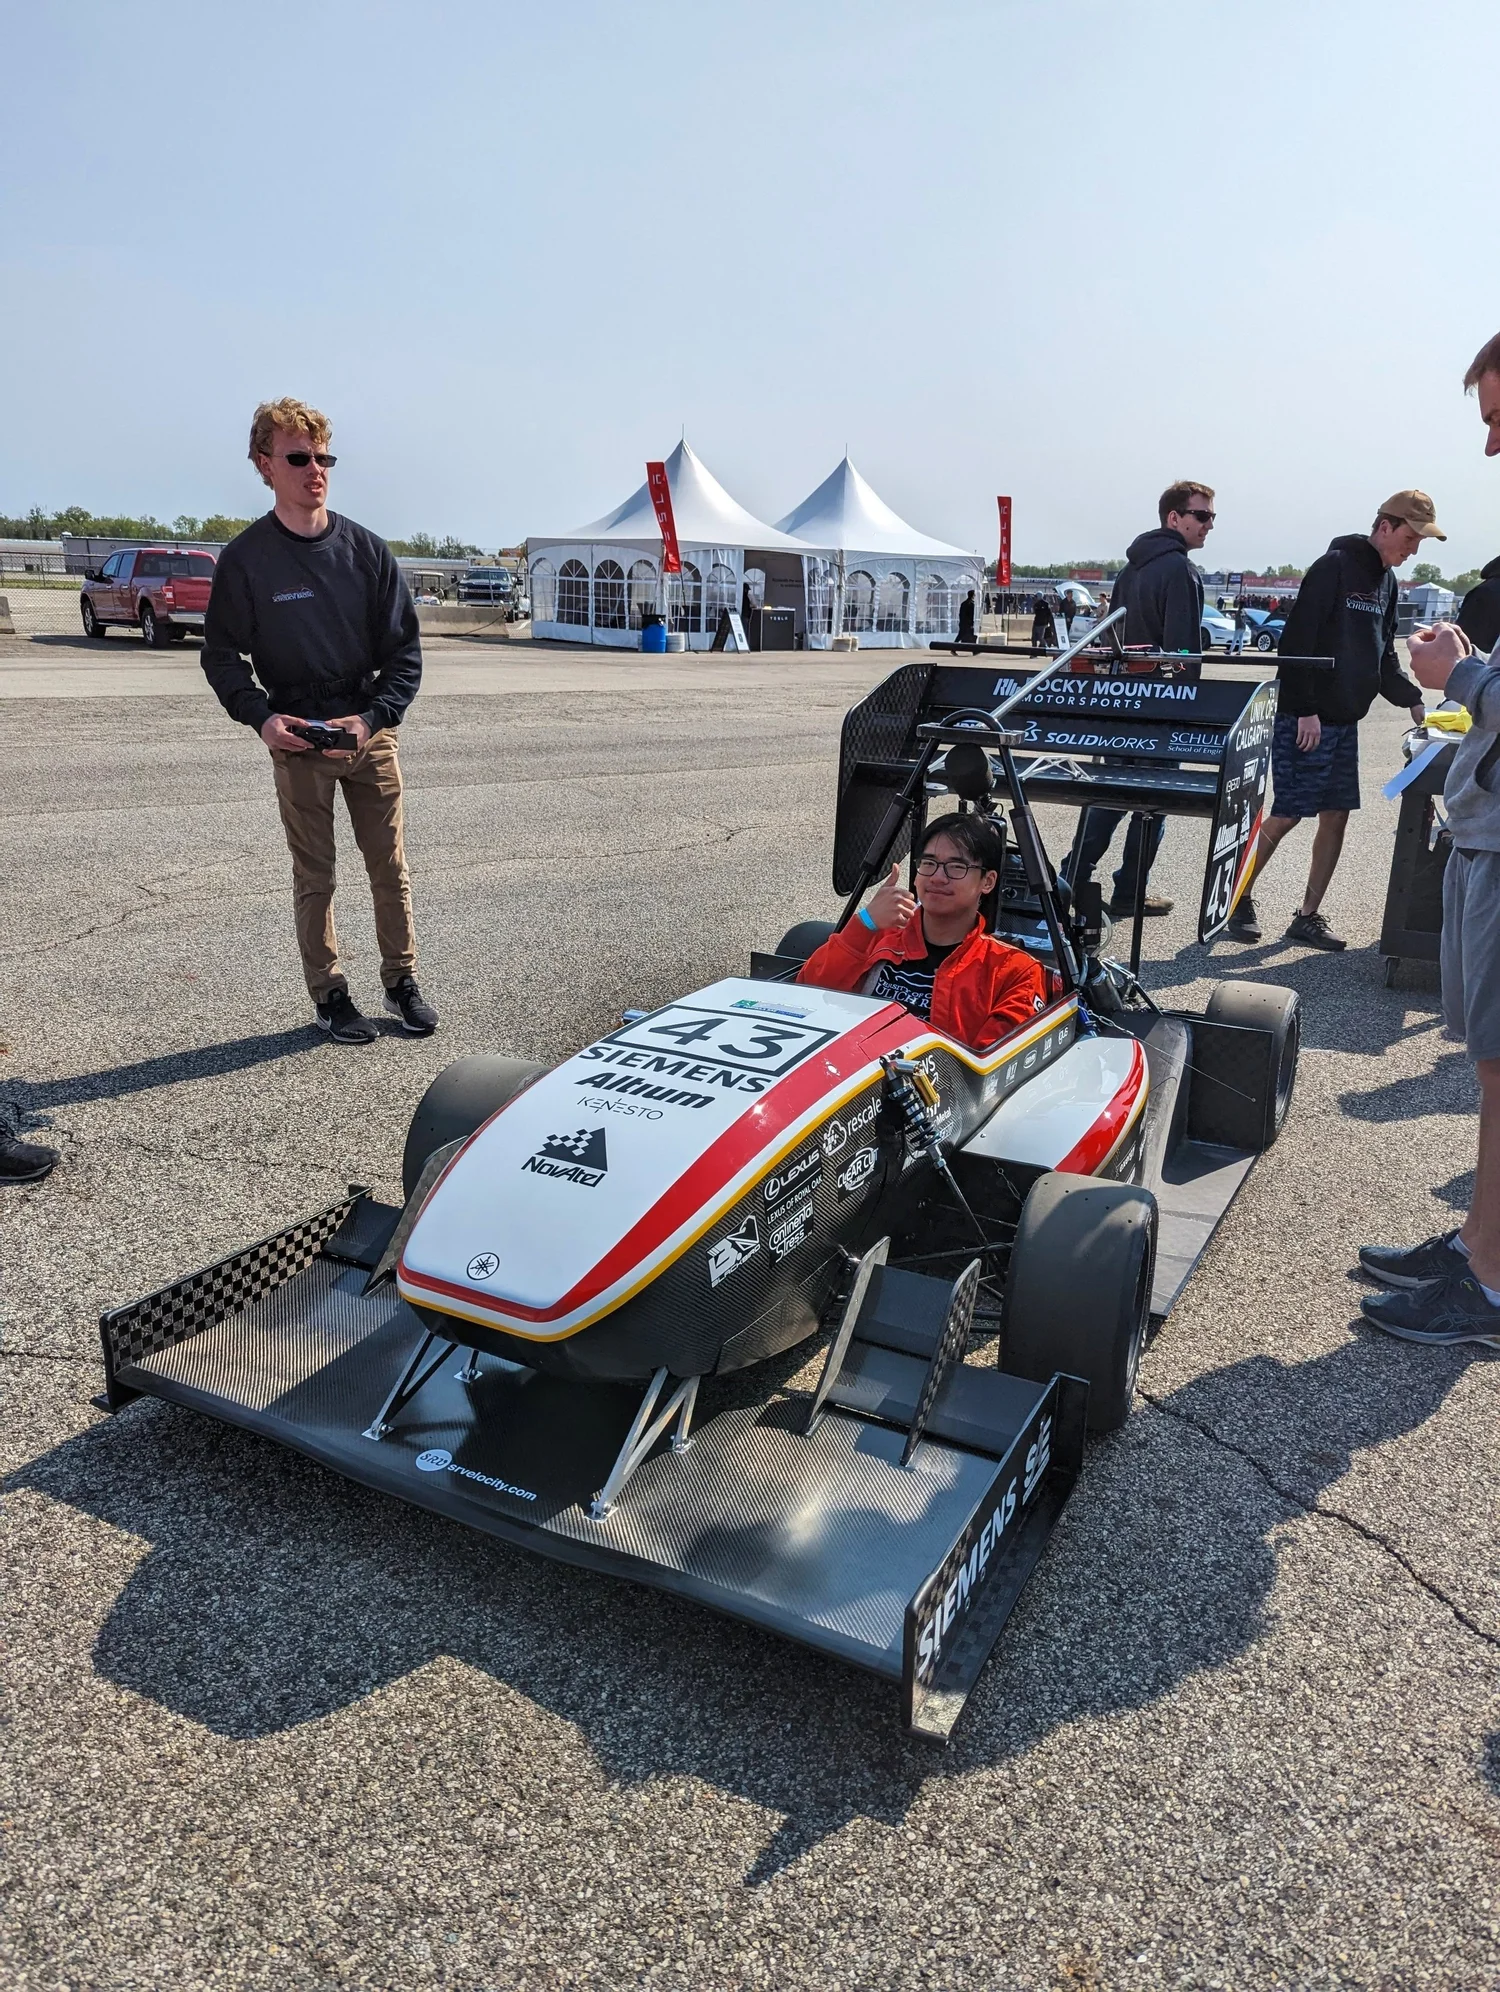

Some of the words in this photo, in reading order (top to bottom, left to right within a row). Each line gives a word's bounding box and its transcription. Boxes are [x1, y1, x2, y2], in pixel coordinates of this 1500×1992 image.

[1026, 677, 1089, 694] OCKY
[1092, 681, 1198, 700] MOUNTAIN
[1044, 732, 1159, 750] SOLIDWORKS
[1170, 731, 1227, 746] SCHULI
[1236, 724, 1264, 751] CALGARY
[1206, 857, 1235, 925] 43
[875, 983, 917, 1005] ULICH
[648, 1018, 806, 1059] 43
[578, 1046, 772, 1093] SIEMENS
[573, 1072, 716, 1109] Altium
[577, 1098, 664, 1120] KENESTO
[847, 1097, 882, 1136] rescale
[521, 1156, 606, 1187] NovAtel
[780, 1149, 820, 1187] LEXUS
[837, 1159, 863, 1188] CLEAR
[863, 1147, 879, 1169] CUT
[767, 1205, 786, 1224] LEXUS
[786, 1196, 795, 1210] OF
[794, 1185, 811, 1203] ROYAL
[811, 1173, 823, 1189] OAK
[769, 1199, 814, 1250] Continental
[447, 1464, 538, 1501] srvelocity.com
[917, 1476, 1017, 1680] SIEMENS
